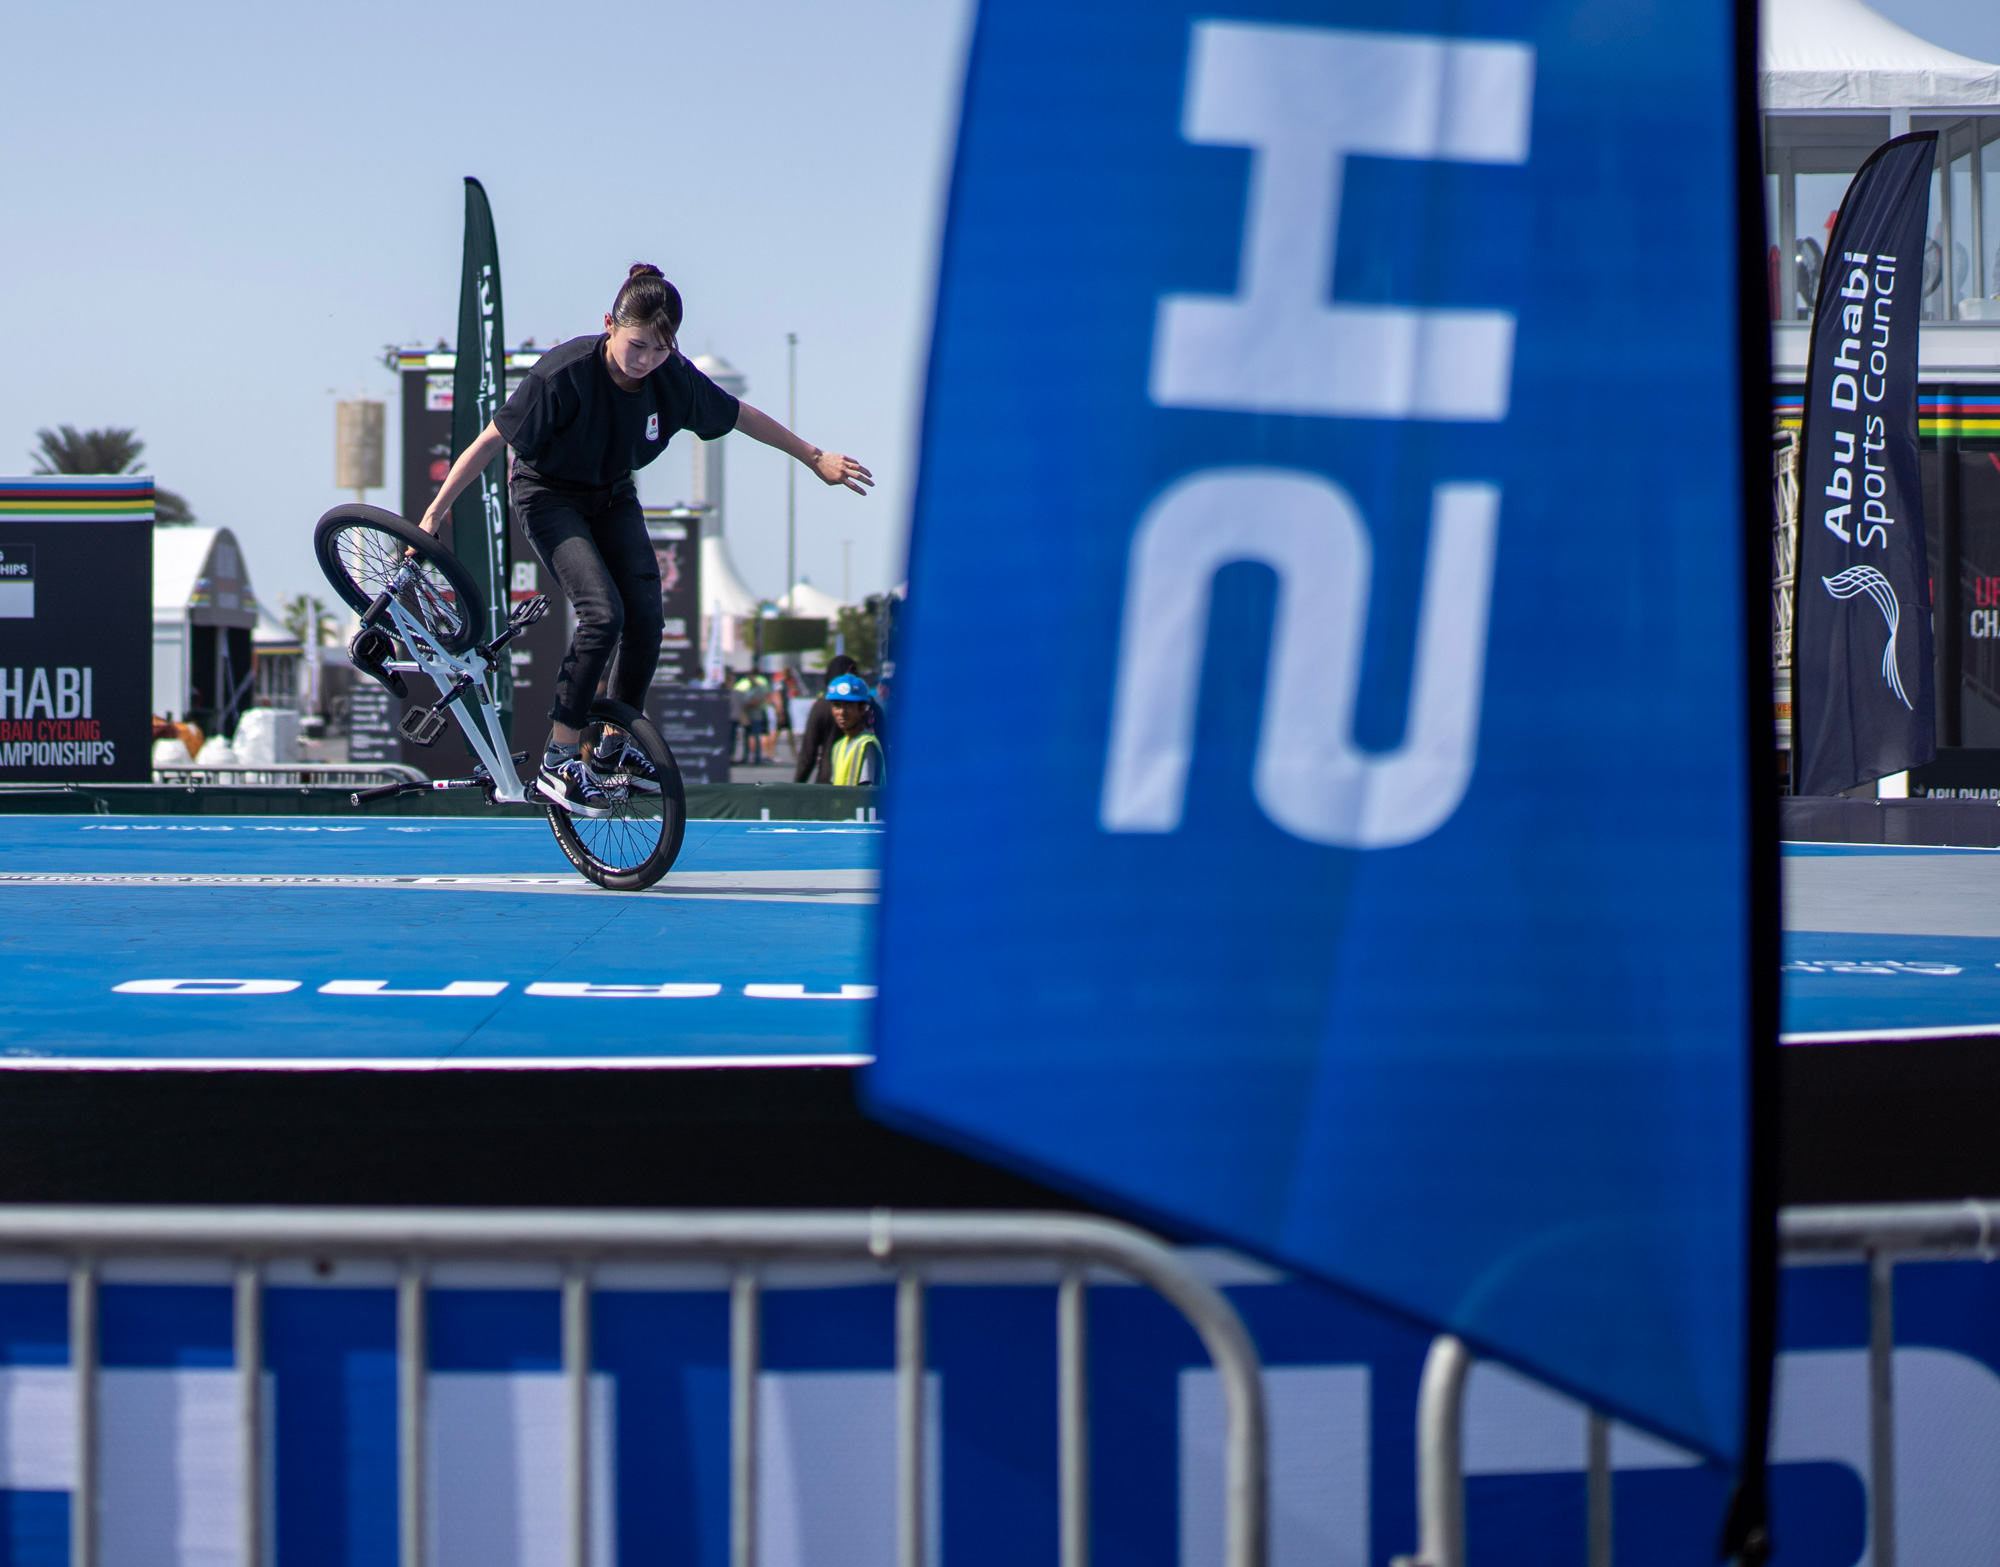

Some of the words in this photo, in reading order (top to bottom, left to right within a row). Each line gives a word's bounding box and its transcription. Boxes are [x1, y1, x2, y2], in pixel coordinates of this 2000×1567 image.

[1831, 252, 1869, 412] Dhabi
[1863, 254, 1897, 402] Council
[1824, 430, 1855, 543] Abu
[1856, 414, 1895, 549] Sports
[1970, 609, 2000, 638] CH
[0, 667, 92, 719] HABI
[0, 720, 33, 741] BAN
[38, 720, 100, 741] CYCLING
